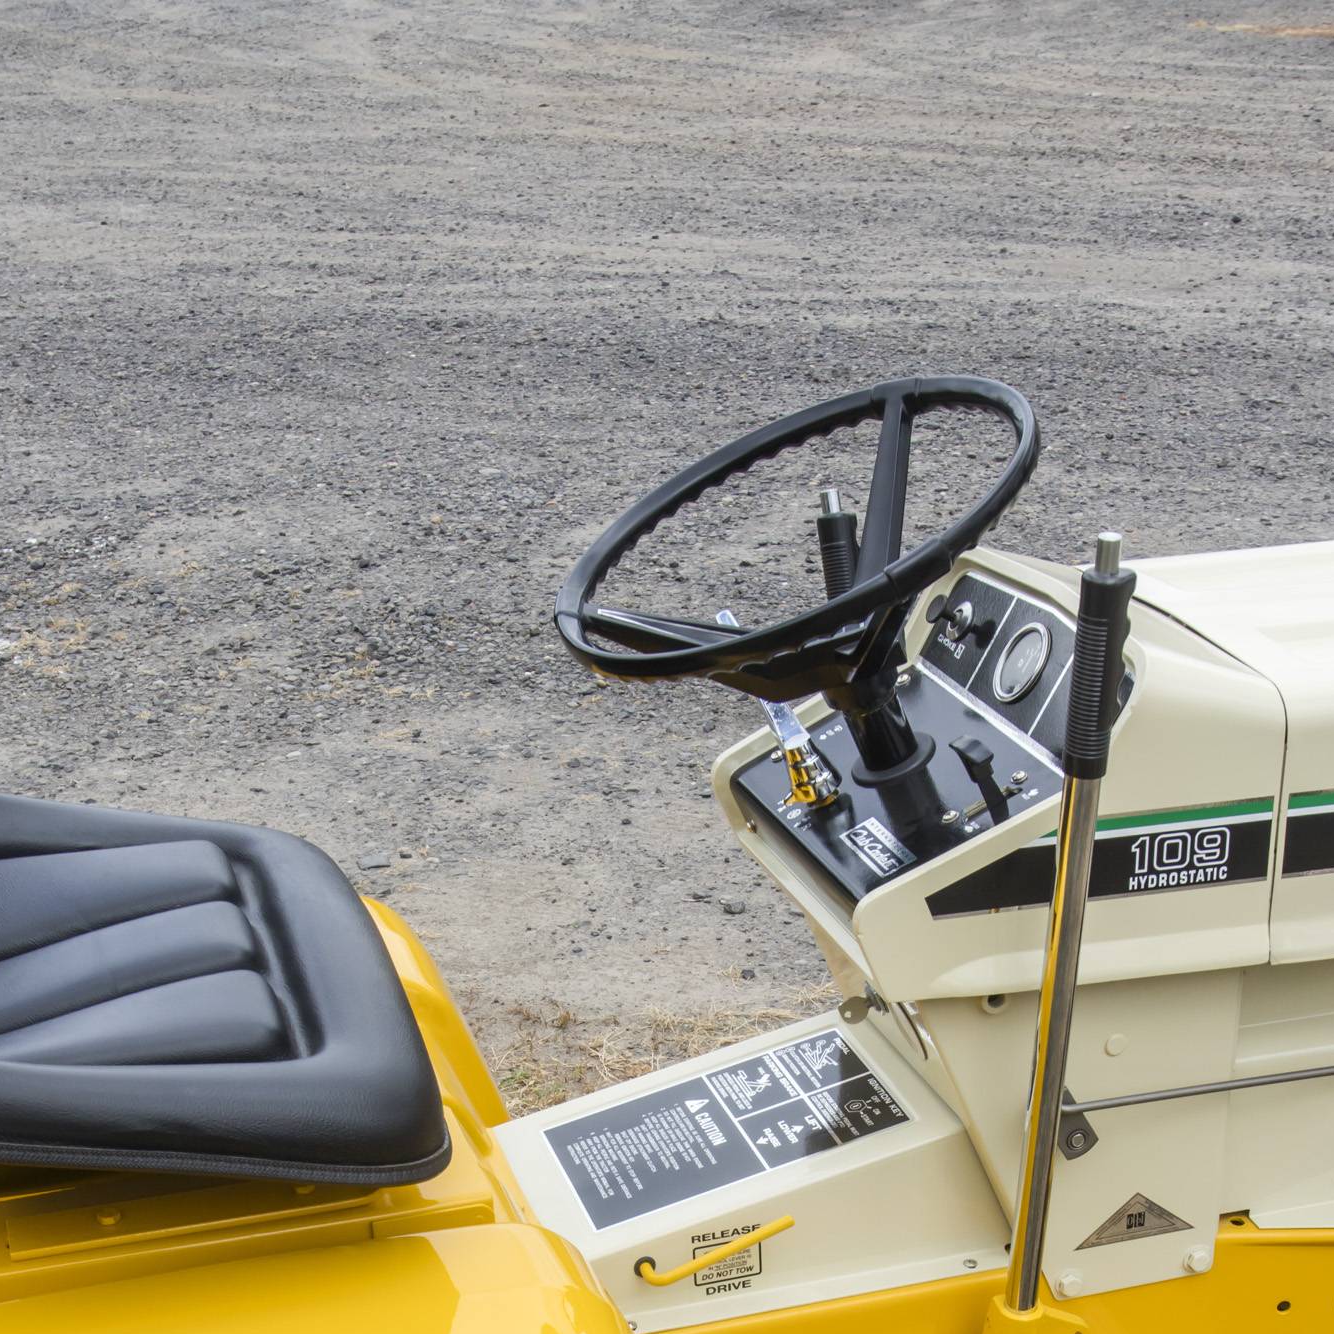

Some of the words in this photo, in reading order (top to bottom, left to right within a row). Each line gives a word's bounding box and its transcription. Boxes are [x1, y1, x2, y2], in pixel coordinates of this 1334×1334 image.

[1131, 826, 1231, 874] 109
[1128, 866, 1228, 891] HYDROSTATIC
[762, 1054, 783, 1078] PARKING
[779, 1077, 798, 1097] BRAKE
[867, 1077, 893, 1105] IGNITION
[888, 1105, 903, 1118] KEY
[695, 1112, 727, 1146] CAUTION
[777, 1120, 799, 1144] LOWER
[804, 1114, 822, 1132] LIFT
[762, 1127, 782, 1148] RAISE
[691, 1224, 762, 1244] RELEASE
[716, 1269, 733, 1278] NOT
[736, 1265, 755, 1275] TOW
[706, 1279, 752, 1296] DRIVE
